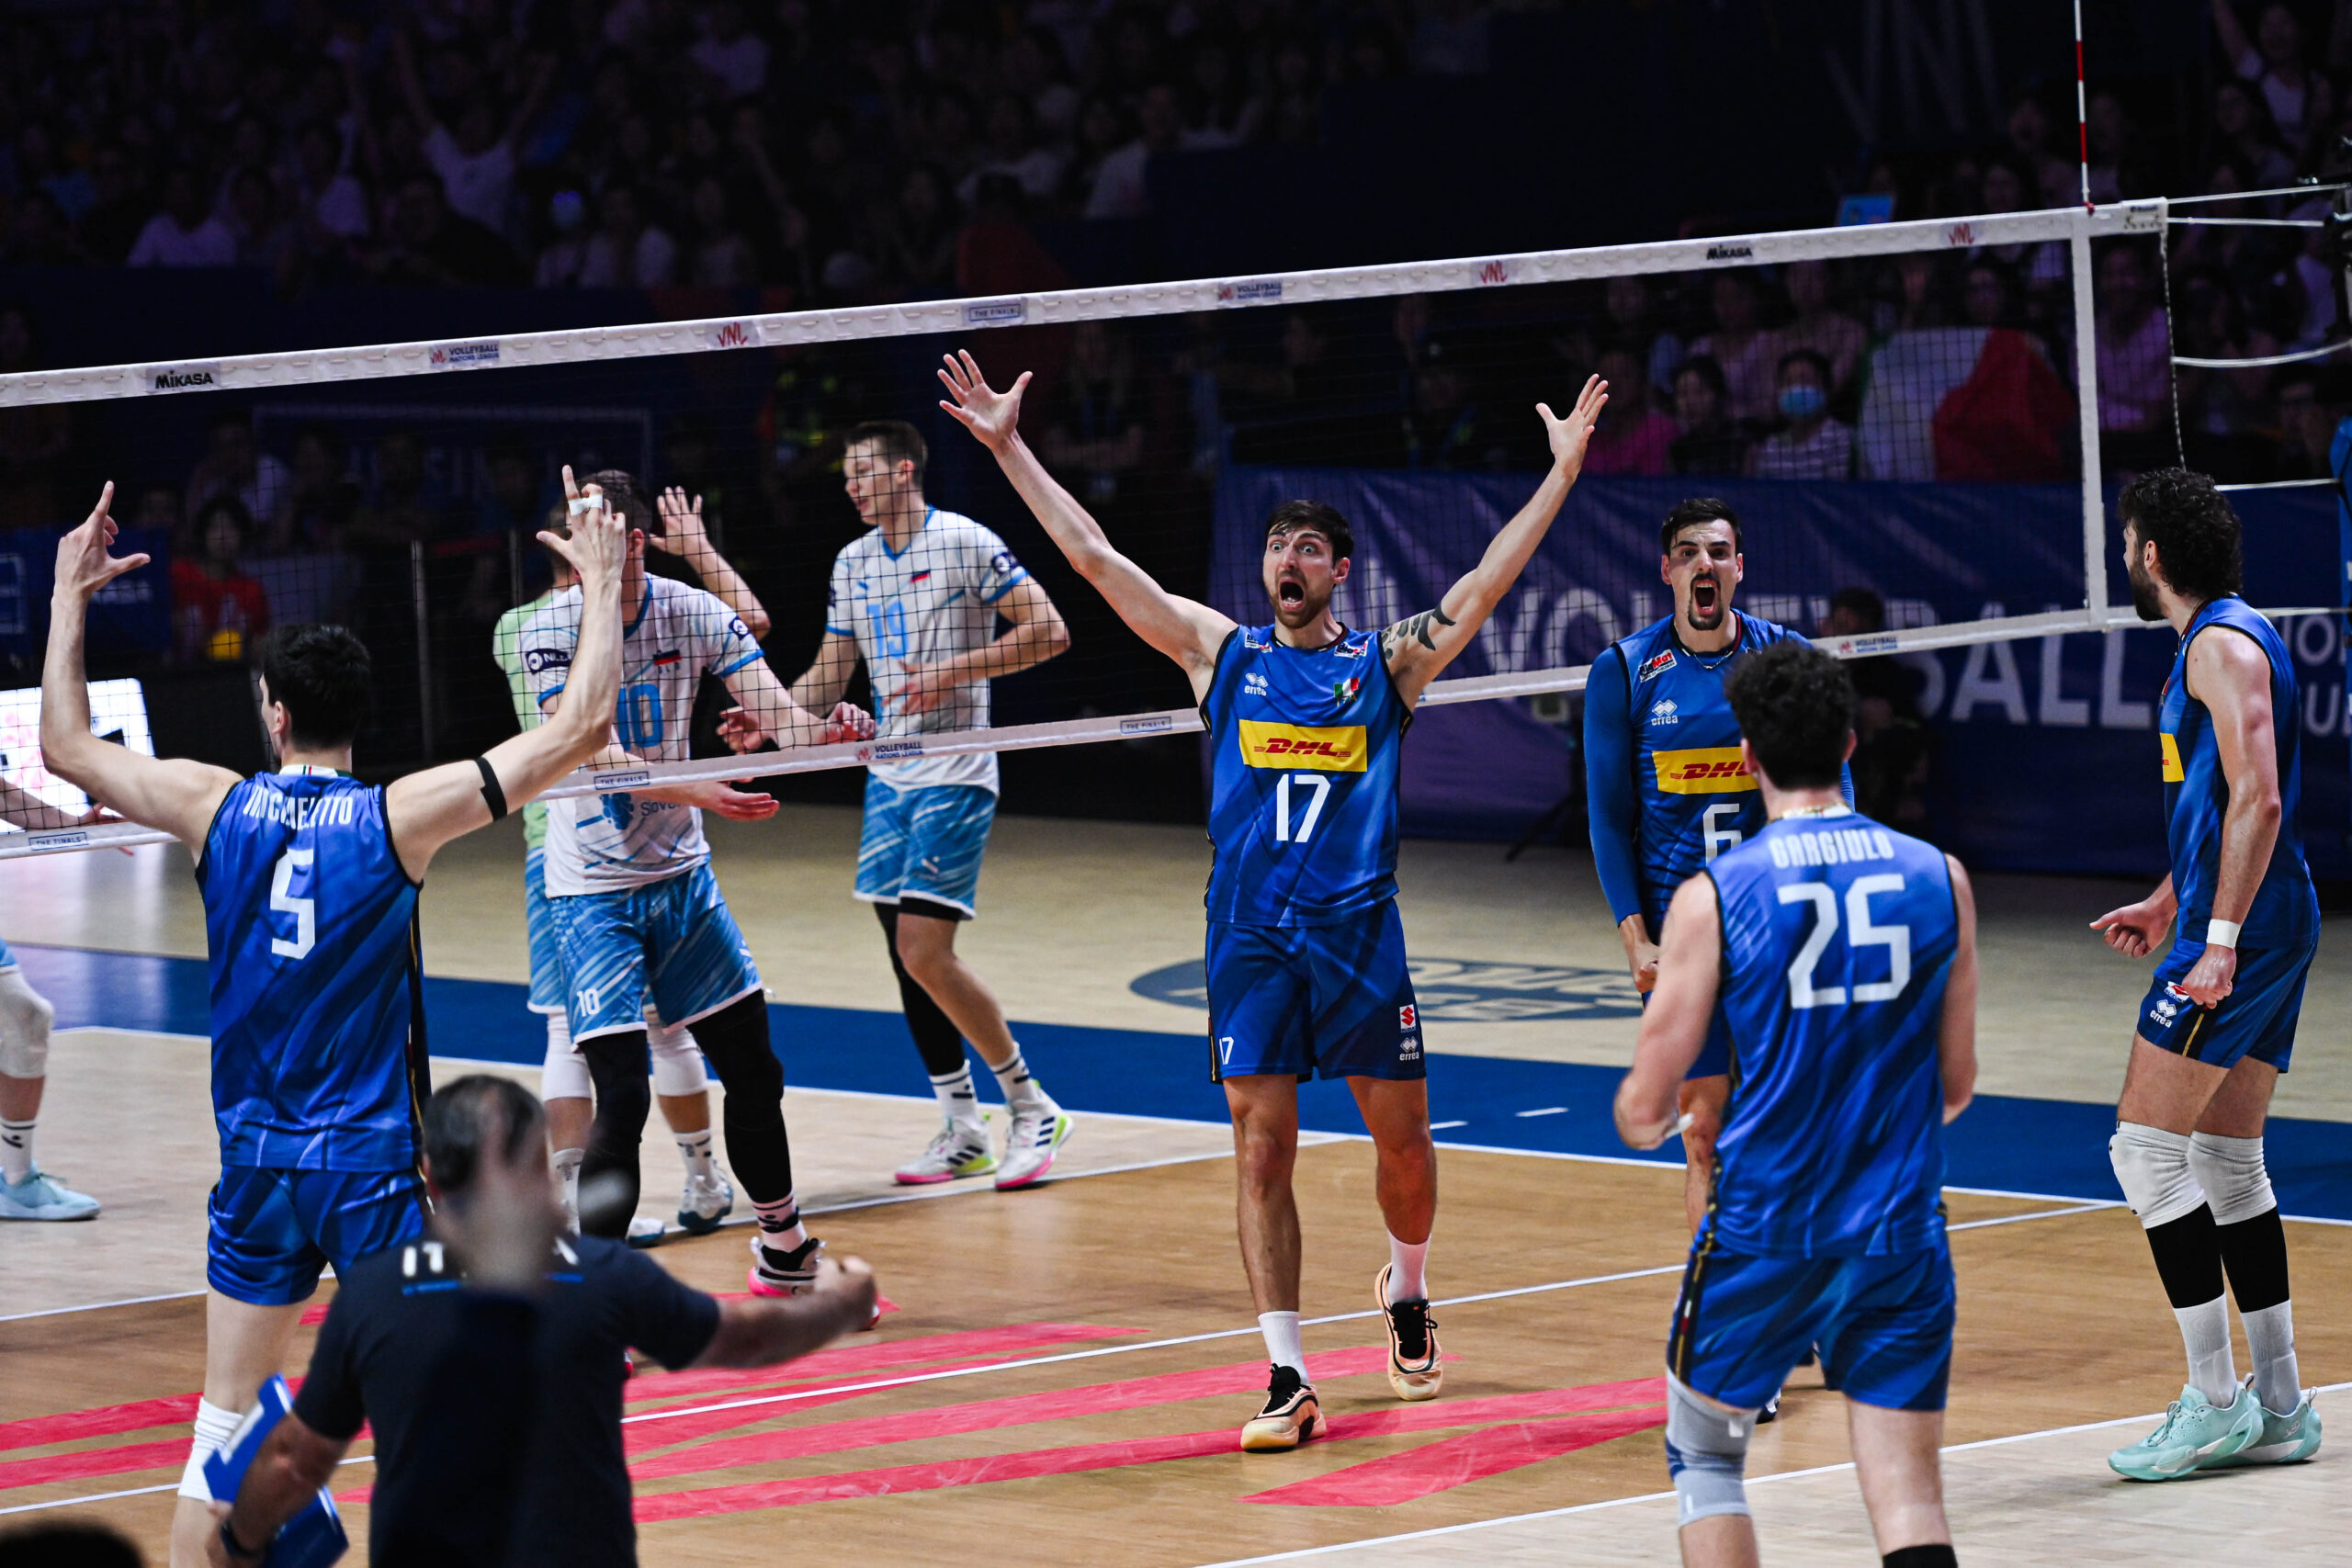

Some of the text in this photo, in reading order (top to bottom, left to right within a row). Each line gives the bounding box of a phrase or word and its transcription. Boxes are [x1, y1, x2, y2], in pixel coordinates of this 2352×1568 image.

[448, 344, 500, 356] VOLLEYBALL
[718, 321, 748, 347] VNL
[866, 601, 910, 660] 19
[616, 682, 664, 751] 10
[875, 741, 922, 752] VOLLEYBALL
[1265, 738, 1339, 757] DHL
[1276, 773, 1331, 842] 17
[1769, 829, 1894, 868] GARGIULO
[270, 849, 315, 959] 5
[1777, 874, 1911, 1009] 25
[577, 988, 601, 1017] 10
[1219, 1037, 1235, 1066] 17
